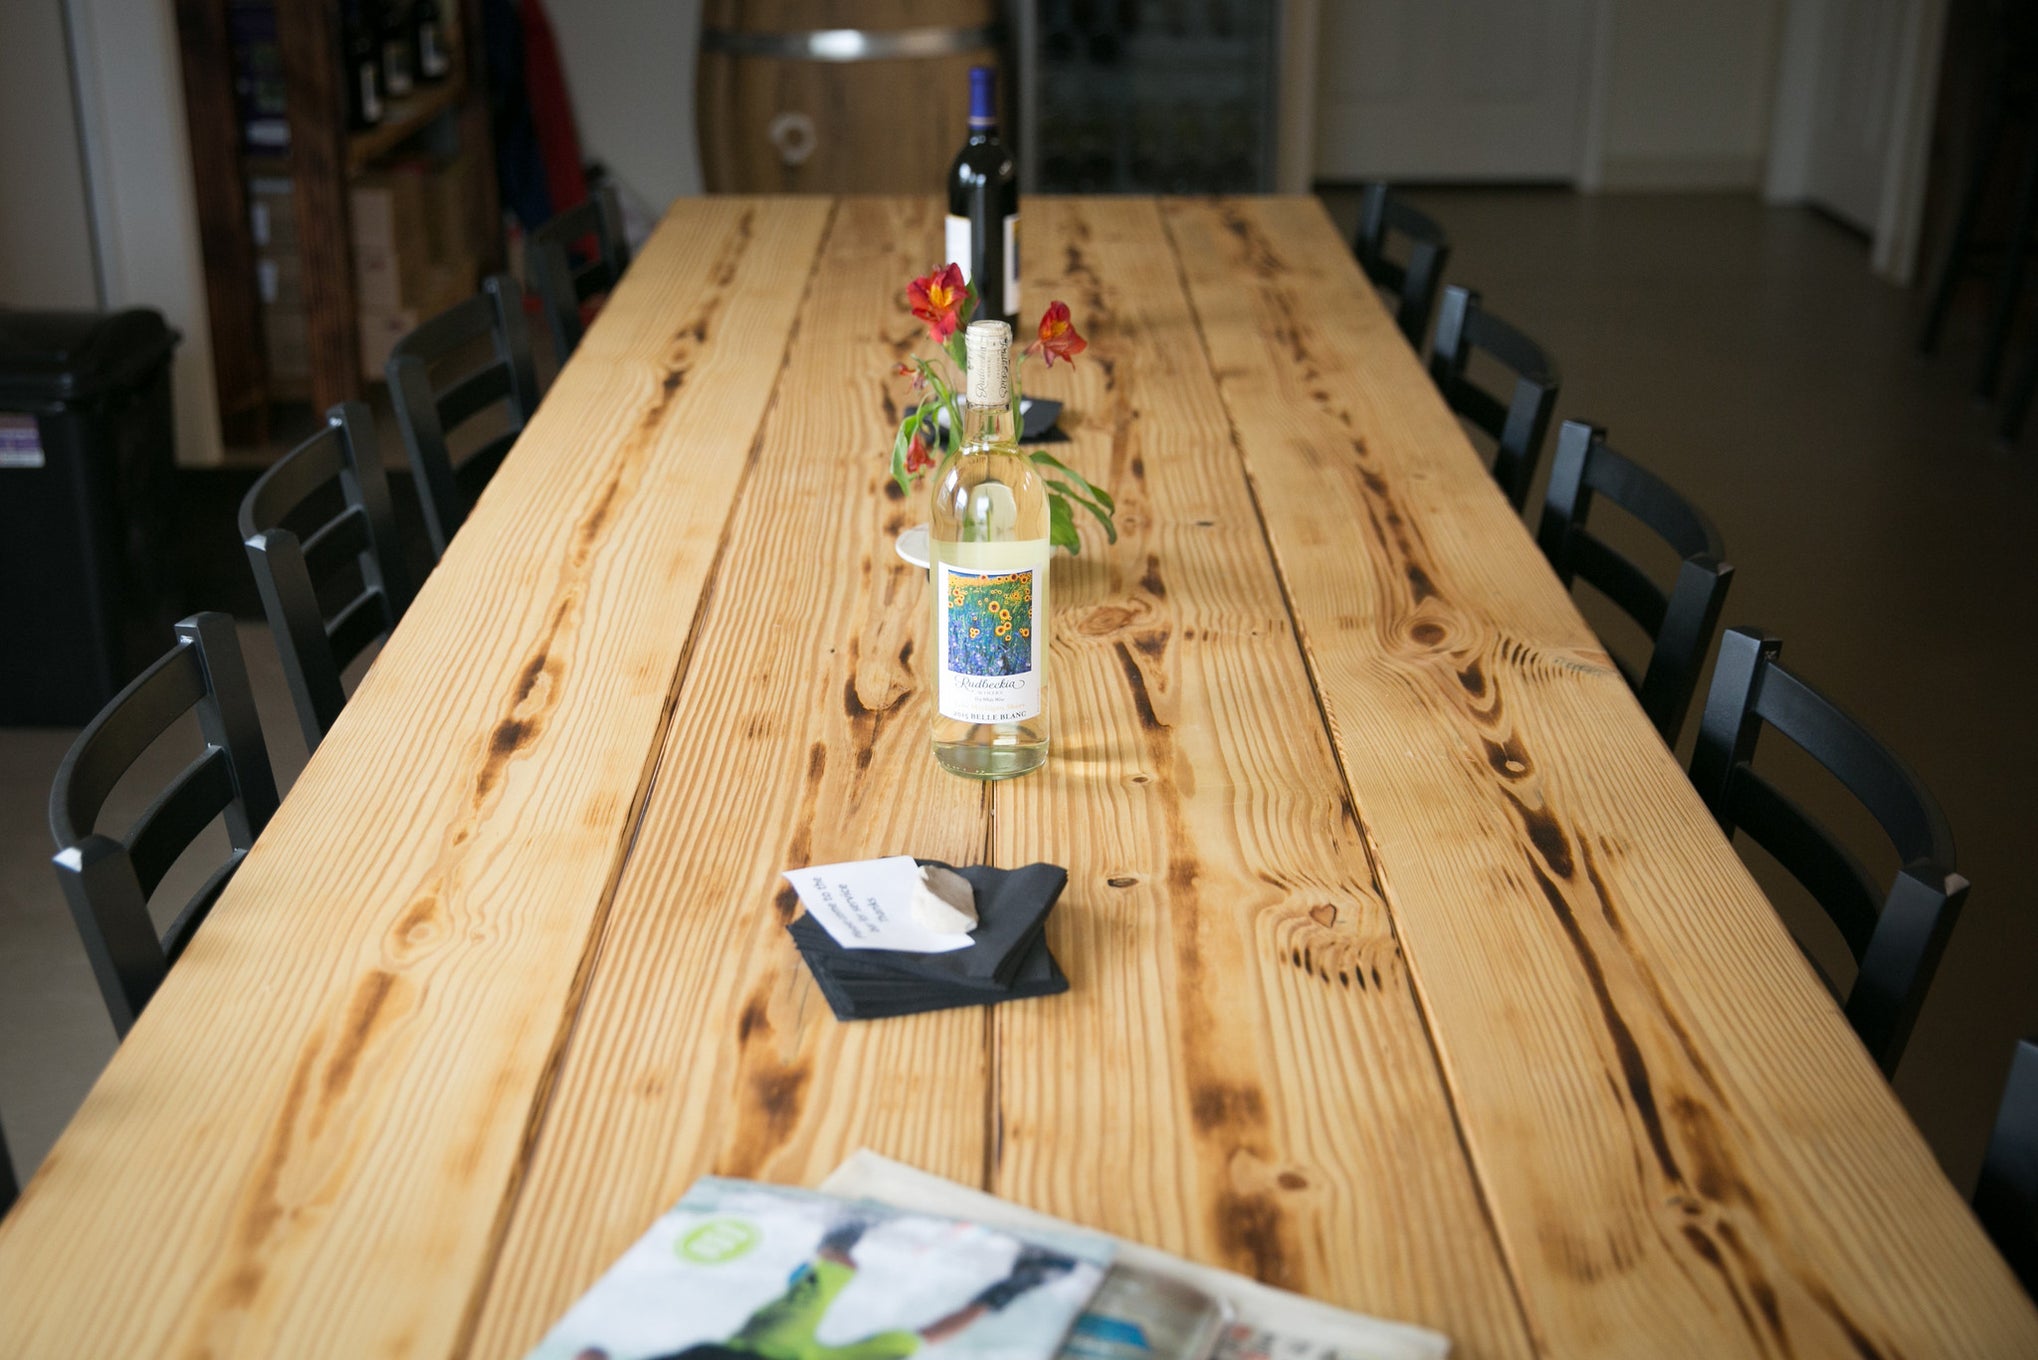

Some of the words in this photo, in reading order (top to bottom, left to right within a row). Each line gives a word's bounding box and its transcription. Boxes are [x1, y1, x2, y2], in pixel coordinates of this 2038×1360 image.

[954, 675, 1026, 692] Rudbeckia
[970, 713, 998, 721] BELLE
[1000, 710, 1027, 721] BLANC
